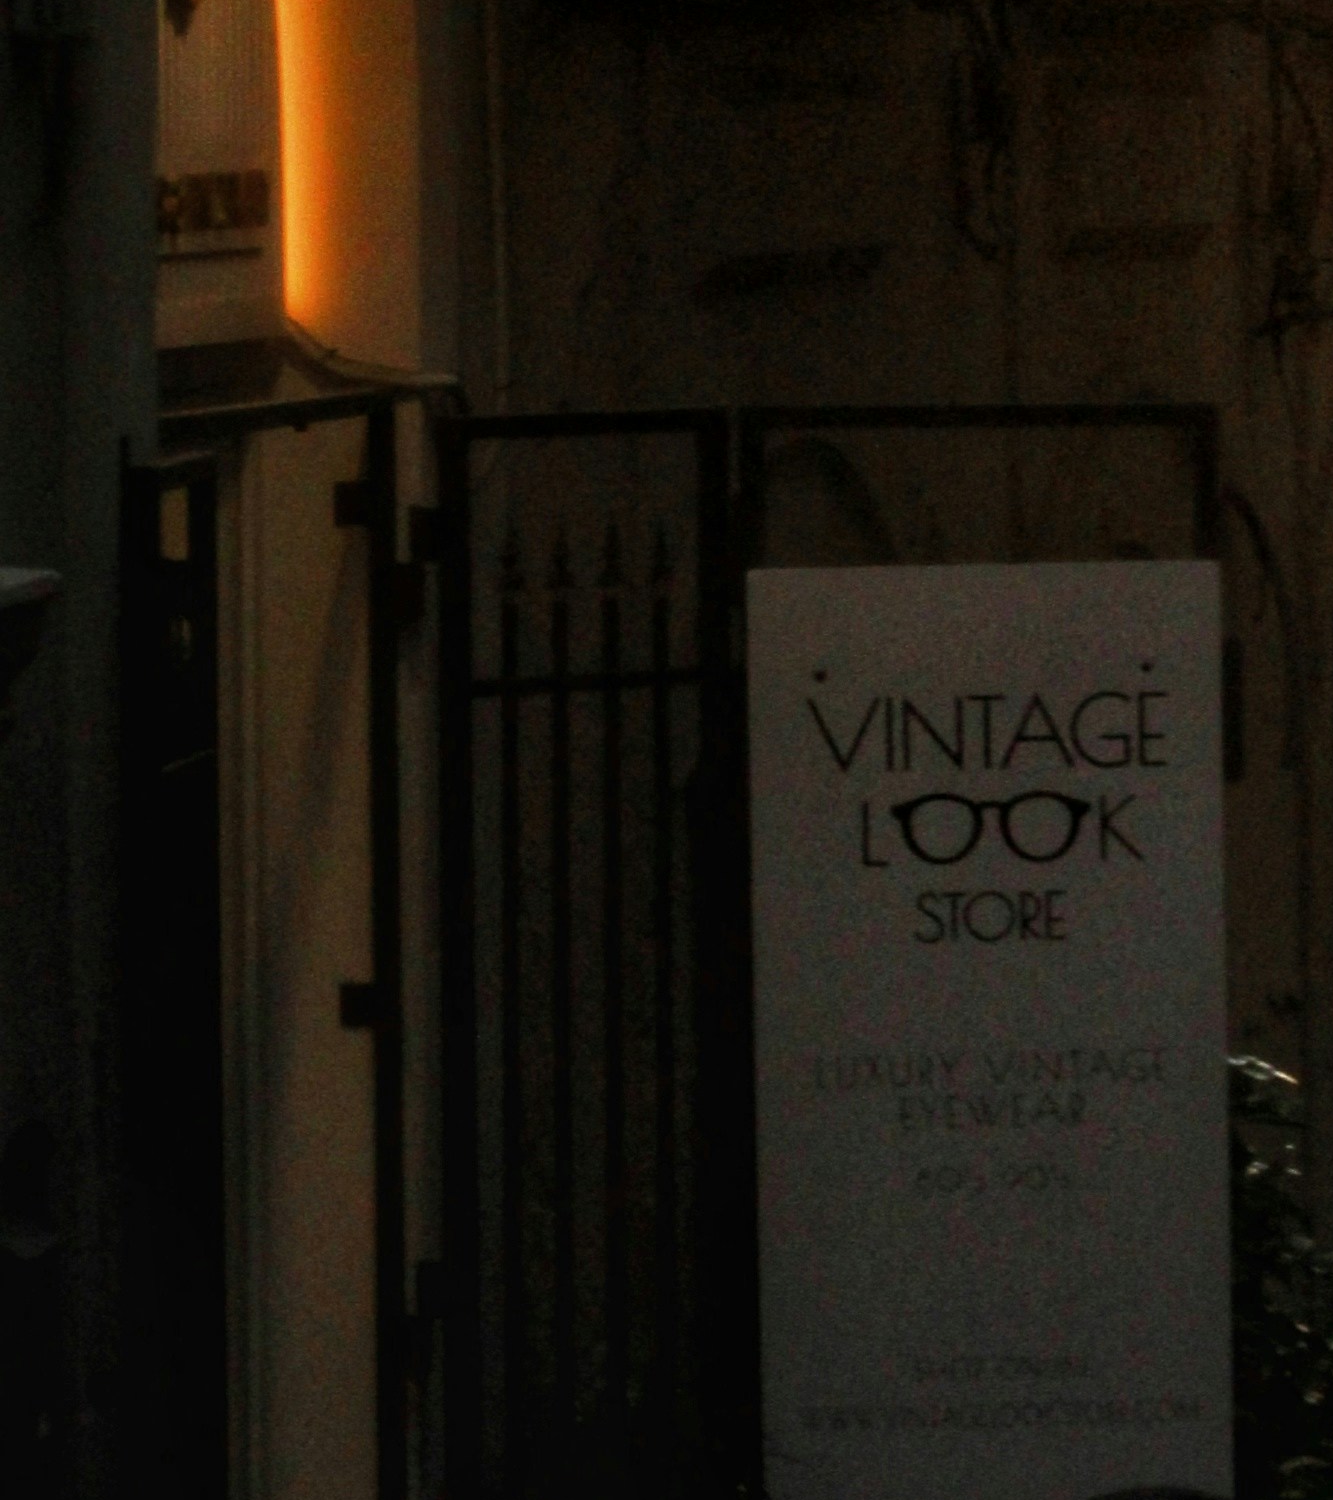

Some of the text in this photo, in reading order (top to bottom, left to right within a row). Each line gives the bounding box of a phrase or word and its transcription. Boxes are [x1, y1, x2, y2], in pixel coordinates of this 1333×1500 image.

[806, 690, 1168, 772] VINTAGE
[861, 791, 1144, 868] LOOK
[914, 890, 1069, 944] STORE
